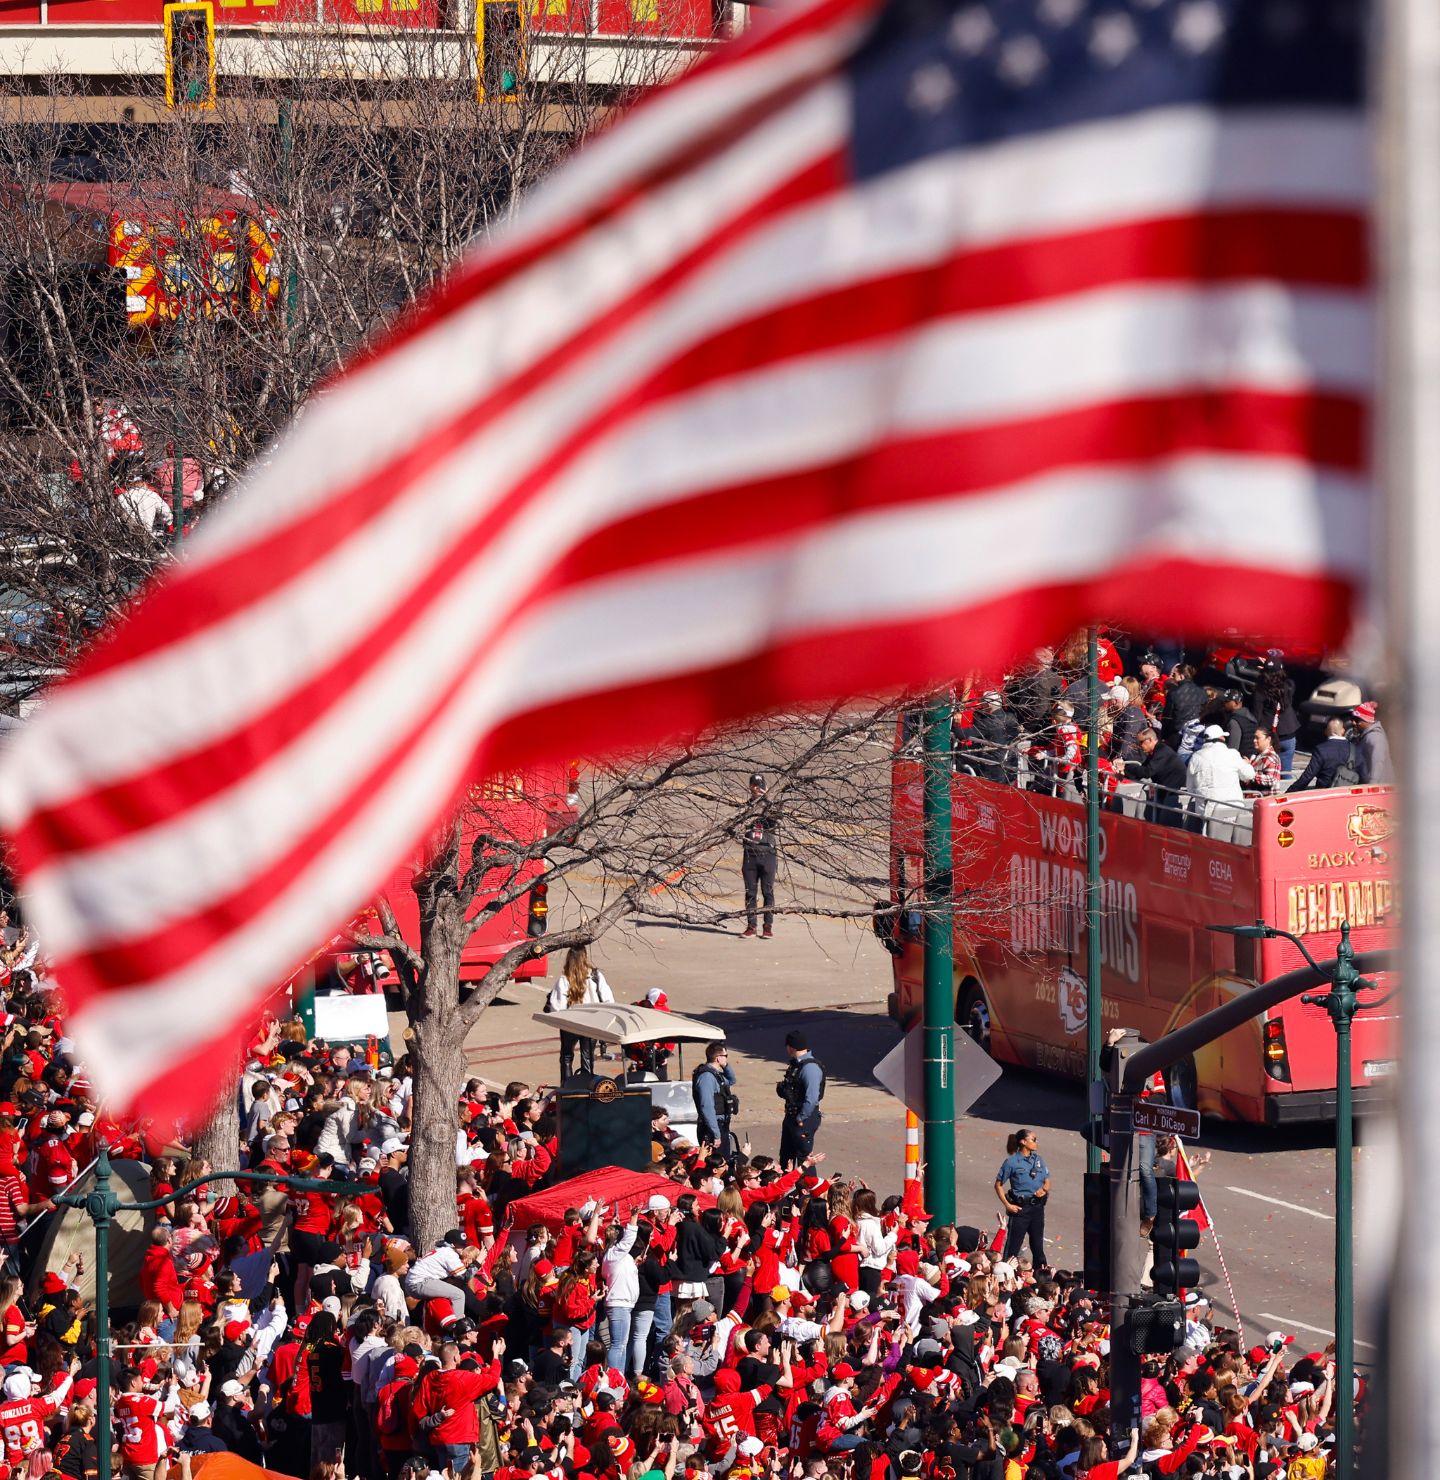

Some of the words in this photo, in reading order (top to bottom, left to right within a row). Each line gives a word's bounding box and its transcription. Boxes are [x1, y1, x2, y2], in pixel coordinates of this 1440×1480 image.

[1038, 810, 1108, 863] WORD
[1208, 859, 1233, 882] GEHA
[1307, 851, 1357, 868] BACK
[1035, 981, 1056, 1004] 2022
[1135, 1111, 1149, 1125] Carl
[1161, 1115, 1185, 1132] DiCapo
[0, 1404, 33, 1421] GONZALEZ
[713, 1414, 741, 1443] 15
